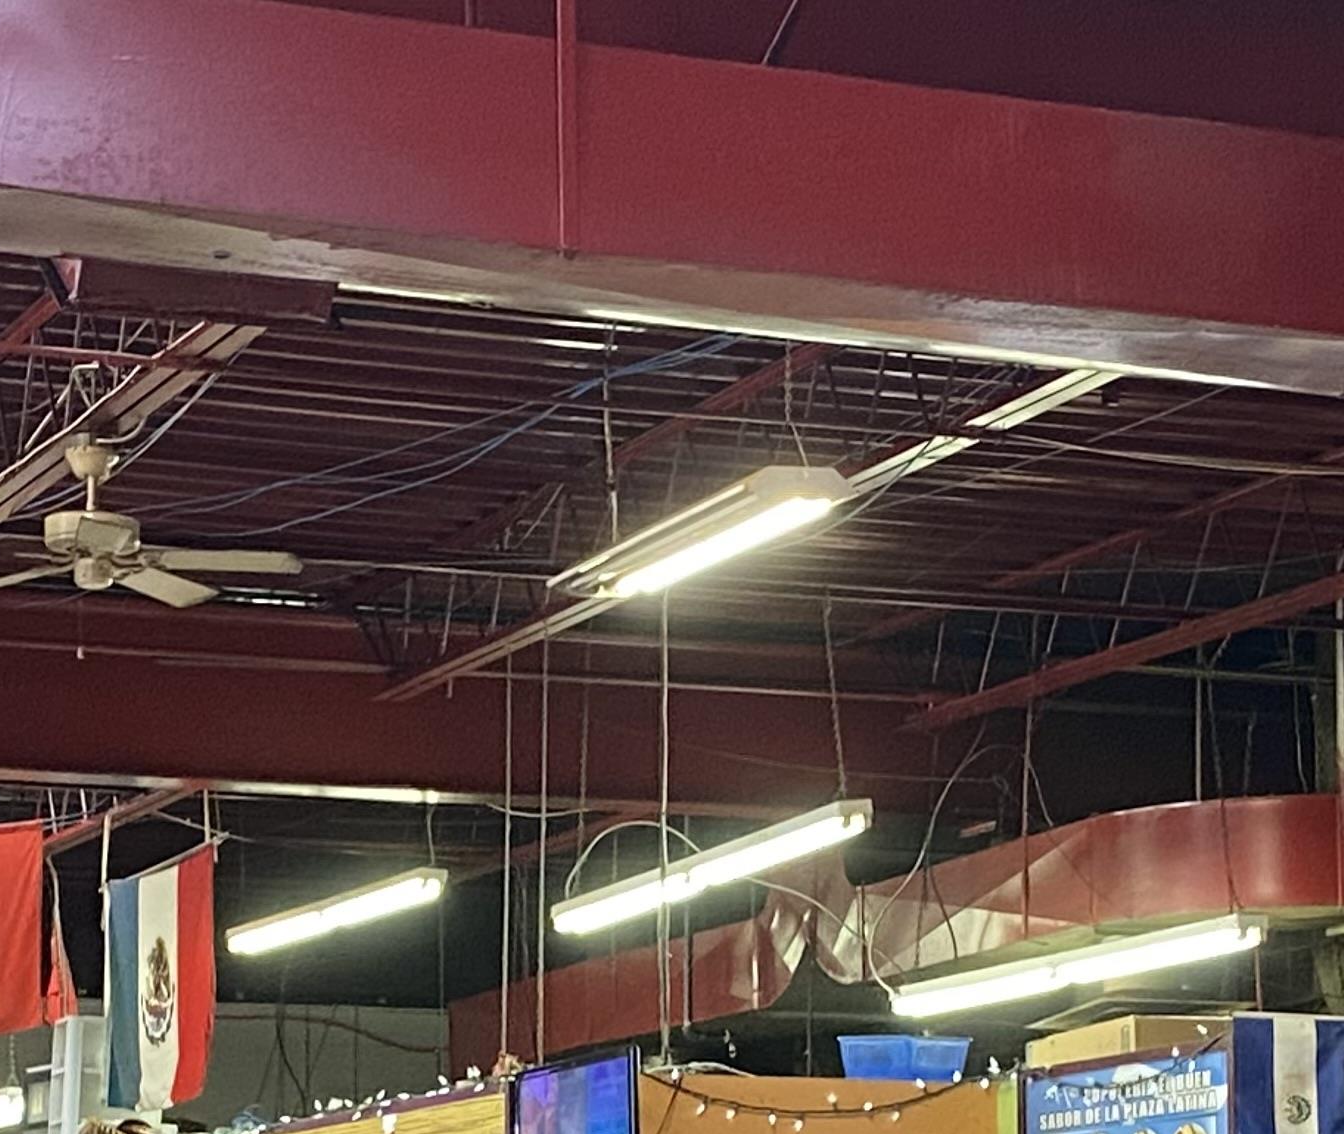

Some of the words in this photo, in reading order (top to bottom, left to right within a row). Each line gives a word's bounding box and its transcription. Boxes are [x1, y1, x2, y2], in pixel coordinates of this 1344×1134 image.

[1039, 1112, 1081, 1131] SABOR
[1084, 1108, 1102, 1125] DE
[1104, 1105, 1120, 1121] LA
[1124, 1099, 1165, 1119] PLAZA
[1168, 1090, 1217, 1113] LATINA
